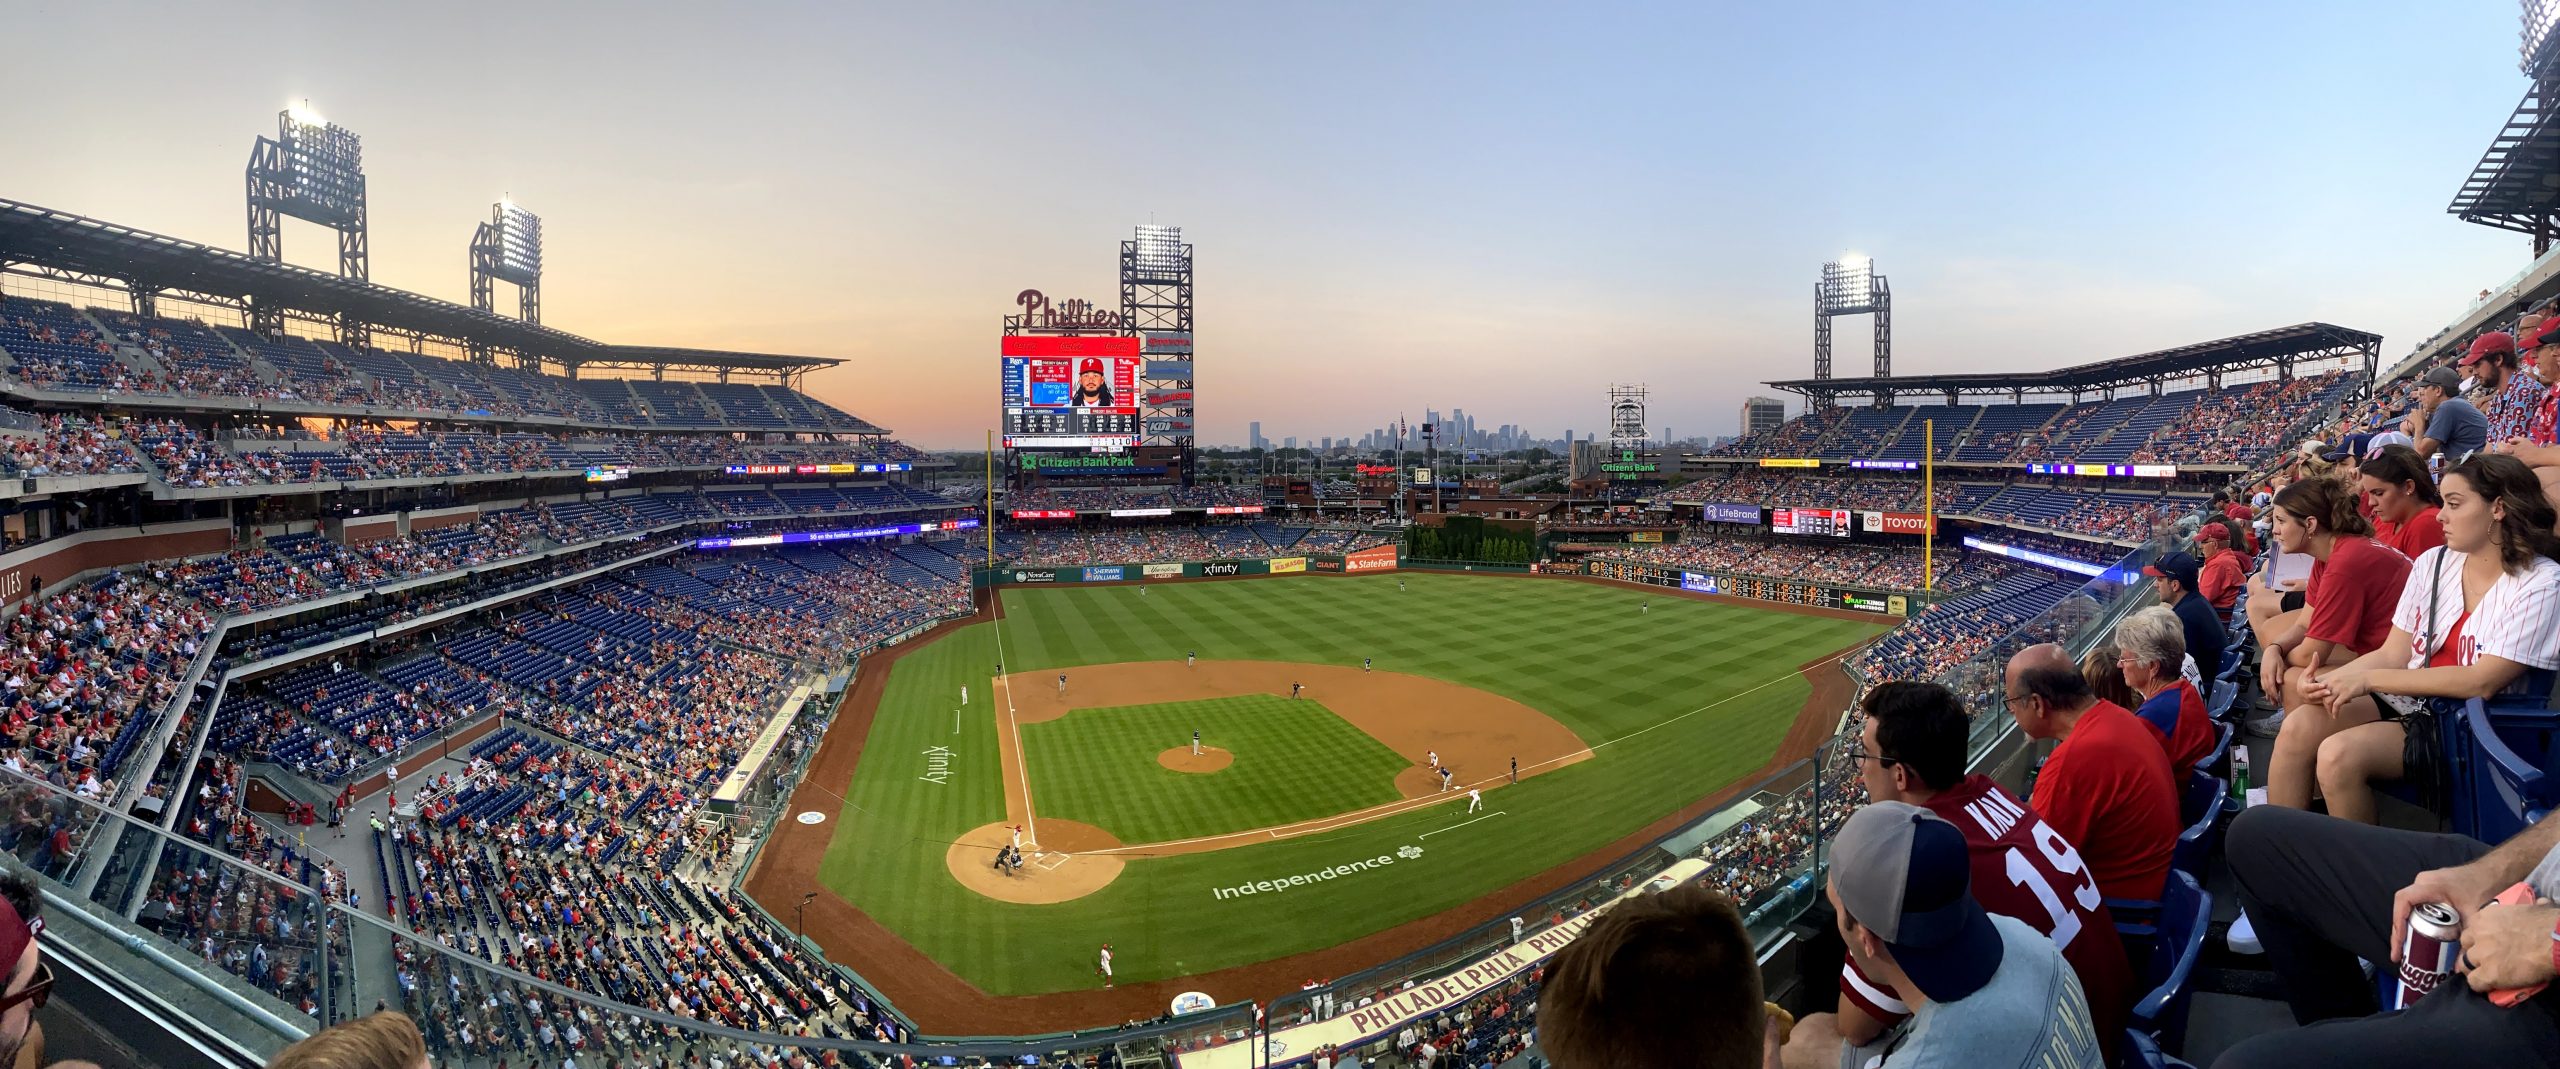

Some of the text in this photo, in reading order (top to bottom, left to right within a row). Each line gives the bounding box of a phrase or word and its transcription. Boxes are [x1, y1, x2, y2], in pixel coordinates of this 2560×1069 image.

[1017, 289, 1121, 328] Phillies
[1038, 456, 1135, 467] Citizens Bank Park
[1720, 509, 1757, 518] LifeBrand
[1, 570, 21, 598] LIES
[1205, 564, 1238, 575] xfinity
[1844, 598, 1885, 606] DRAFTKINGS
[919, 746, 956, 784] xfinity
[1964, 787, 2025, 841] KAUK
[1213, 855, 1394, 900] Independence
[2005, 819, 2101, 952] 19
[1350, 952, 1526, 1033] PHILADELPHIA
